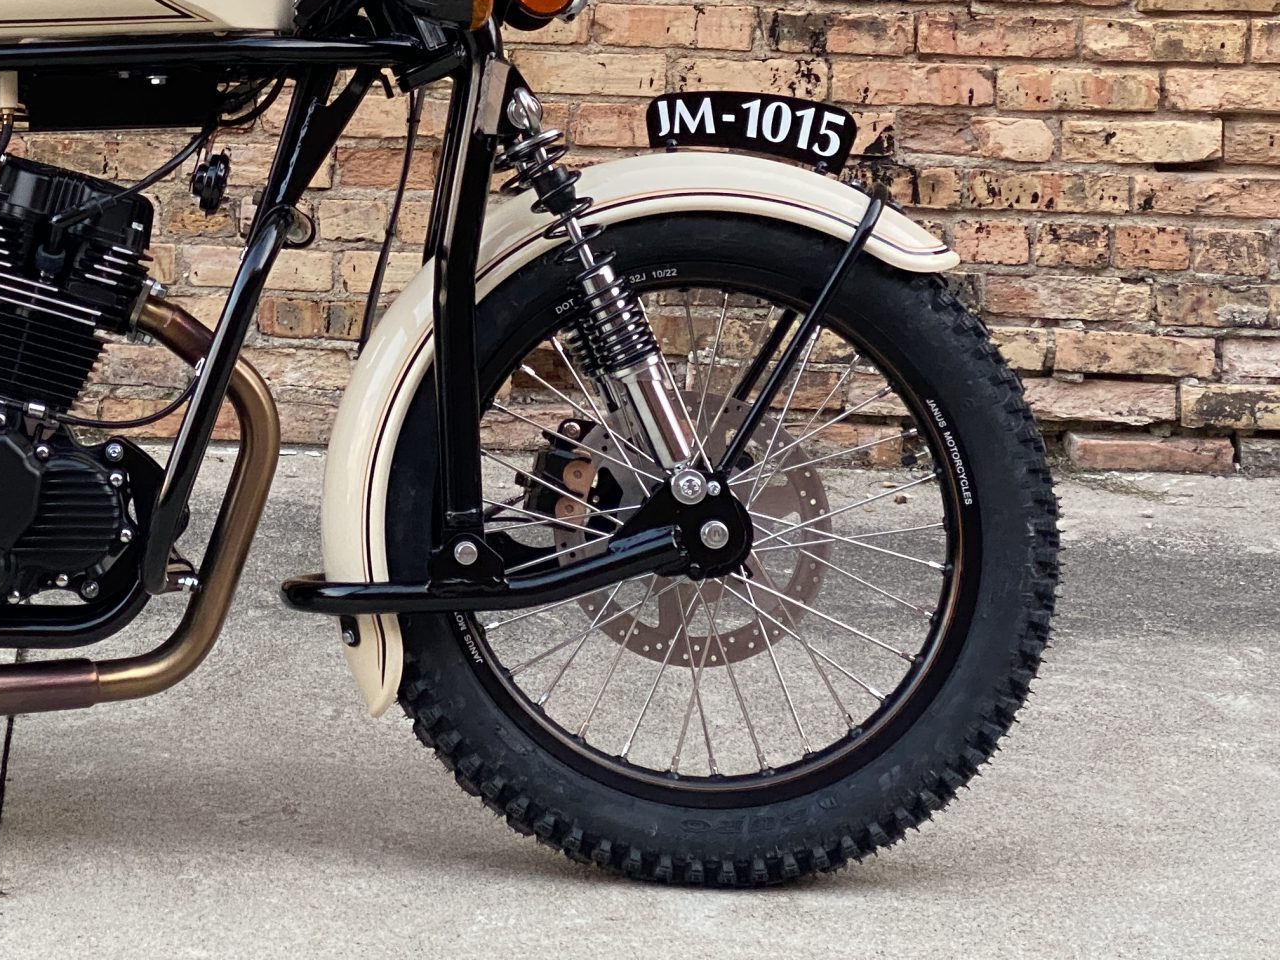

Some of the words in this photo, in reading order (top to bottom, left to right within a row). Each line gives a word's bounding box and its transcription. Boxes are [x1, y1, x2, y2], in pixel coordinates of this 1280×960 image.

[657, 97, 846, 157] JM-1015
[555, 298, 575, 315] DOT
[629, 273, 646, 284] 32J
[652, 268, 678, 279] 10/22
[926, 398, 947, 428] JANUS
[943, 431, 973, 505] MOTORCYCLES
[463, 634, 484, 663] JANUS
